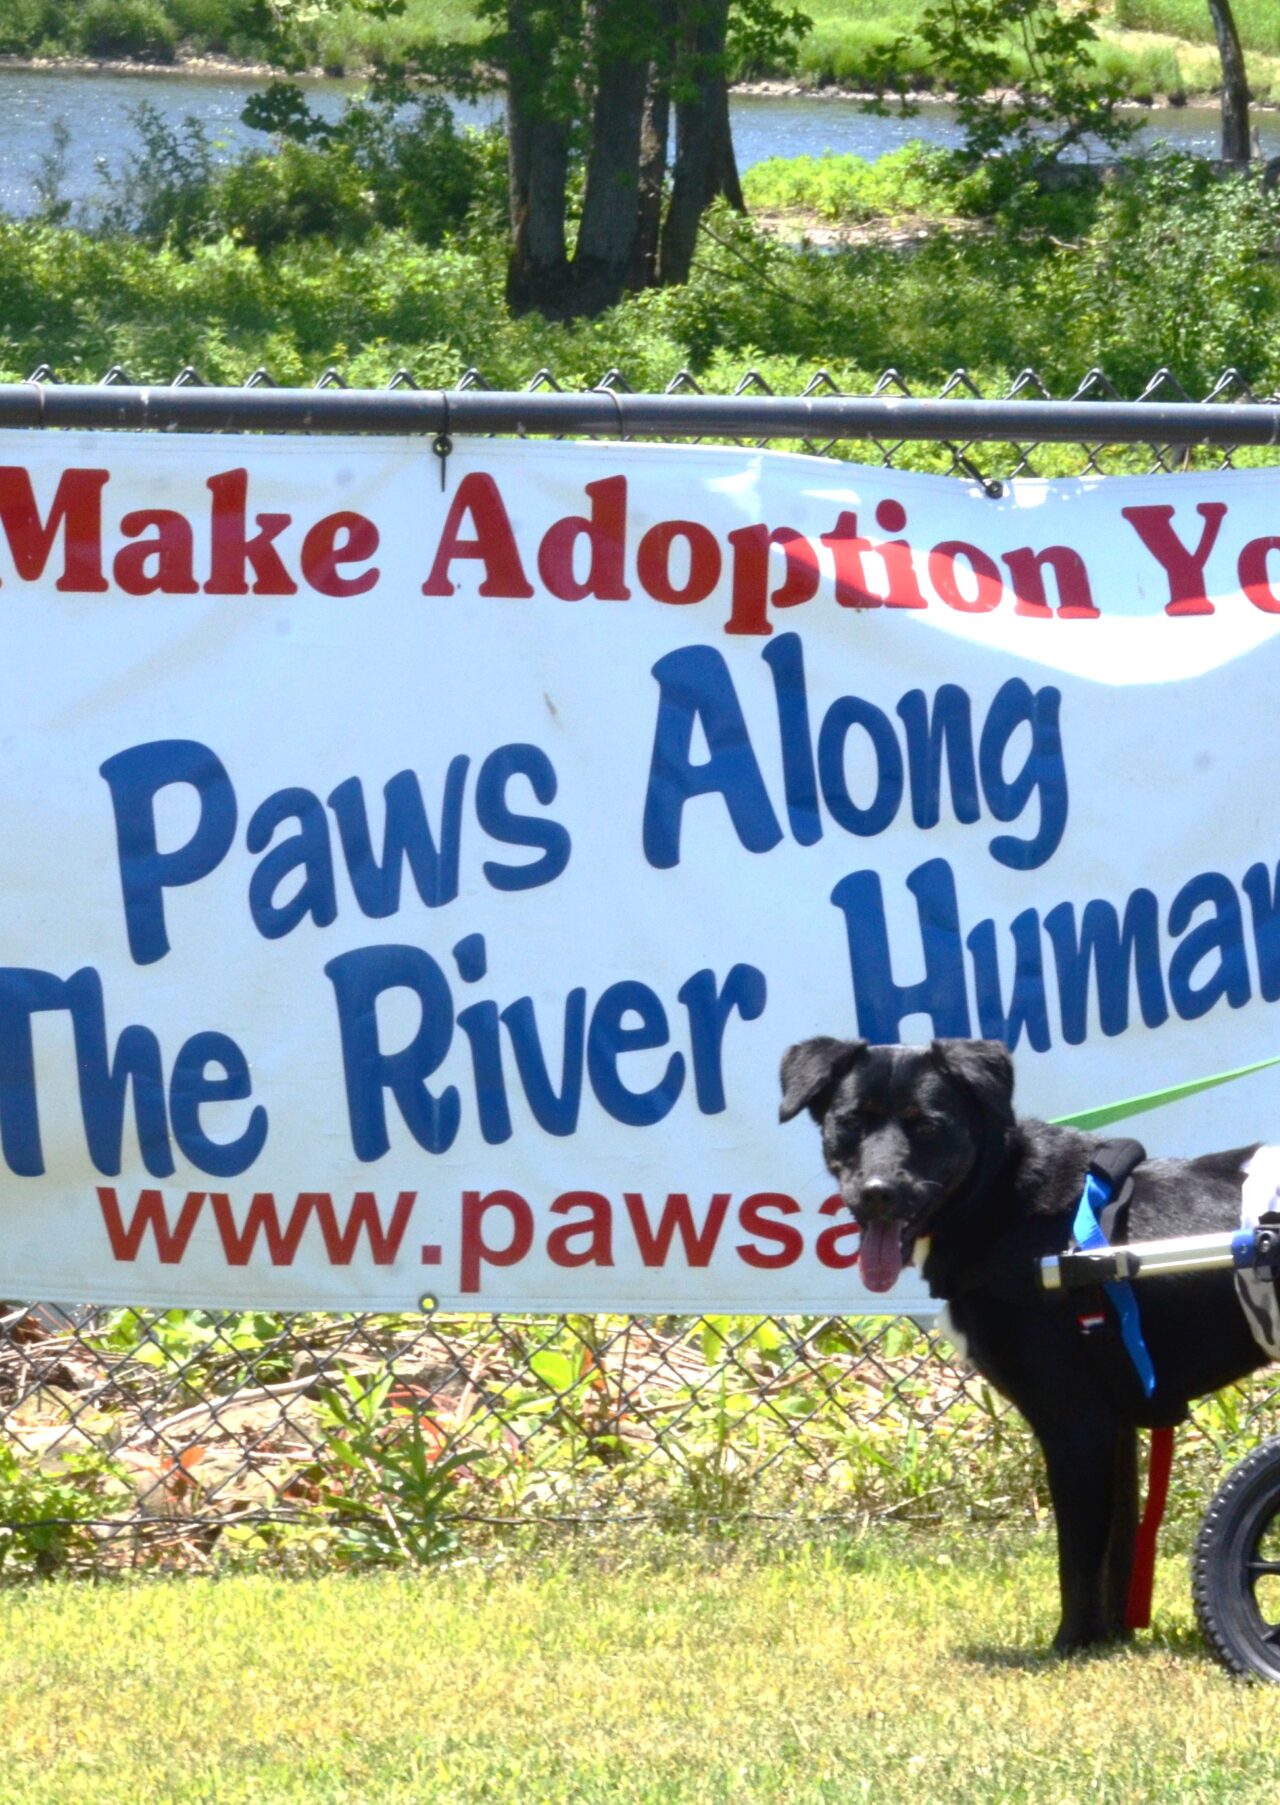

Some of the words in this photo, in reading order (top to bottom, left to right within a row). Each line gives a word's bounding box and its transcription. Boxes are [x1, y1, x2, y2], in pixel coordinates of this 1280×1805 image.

[0, 466, 381, 598] Make
[422, 472, 1101, 636] Adoption
[98, 739, 572, 966] Paws
[642, 631, 1069, 871] Along
[0, 966, 269, 1178] The
[325, 932, 767, 1162] River
